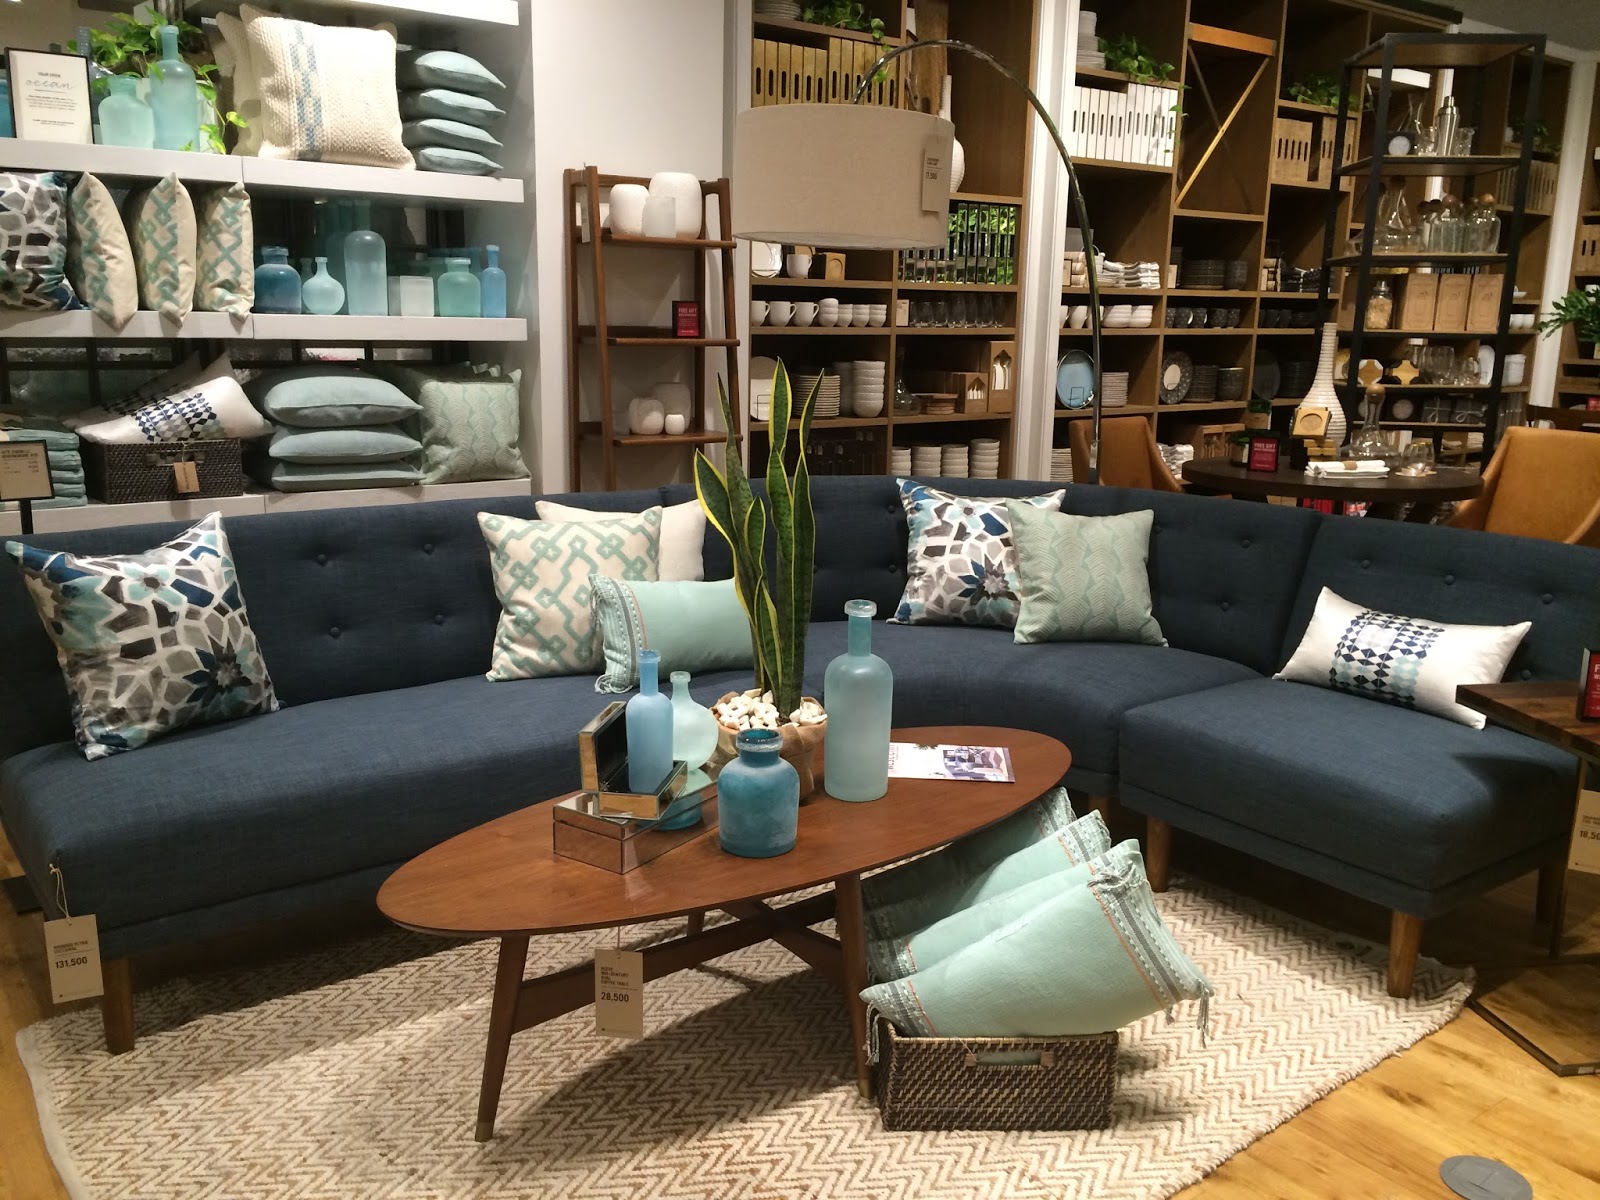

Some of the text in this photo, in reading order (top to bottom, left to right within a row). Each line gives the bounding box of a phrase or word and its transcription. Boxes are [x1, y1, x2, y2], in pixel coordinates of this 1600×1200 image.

[25, 79, 75, 90] ocean
[55, 956, 88, 969] 131,500
[601, 991, 629, 1003] 28,500
